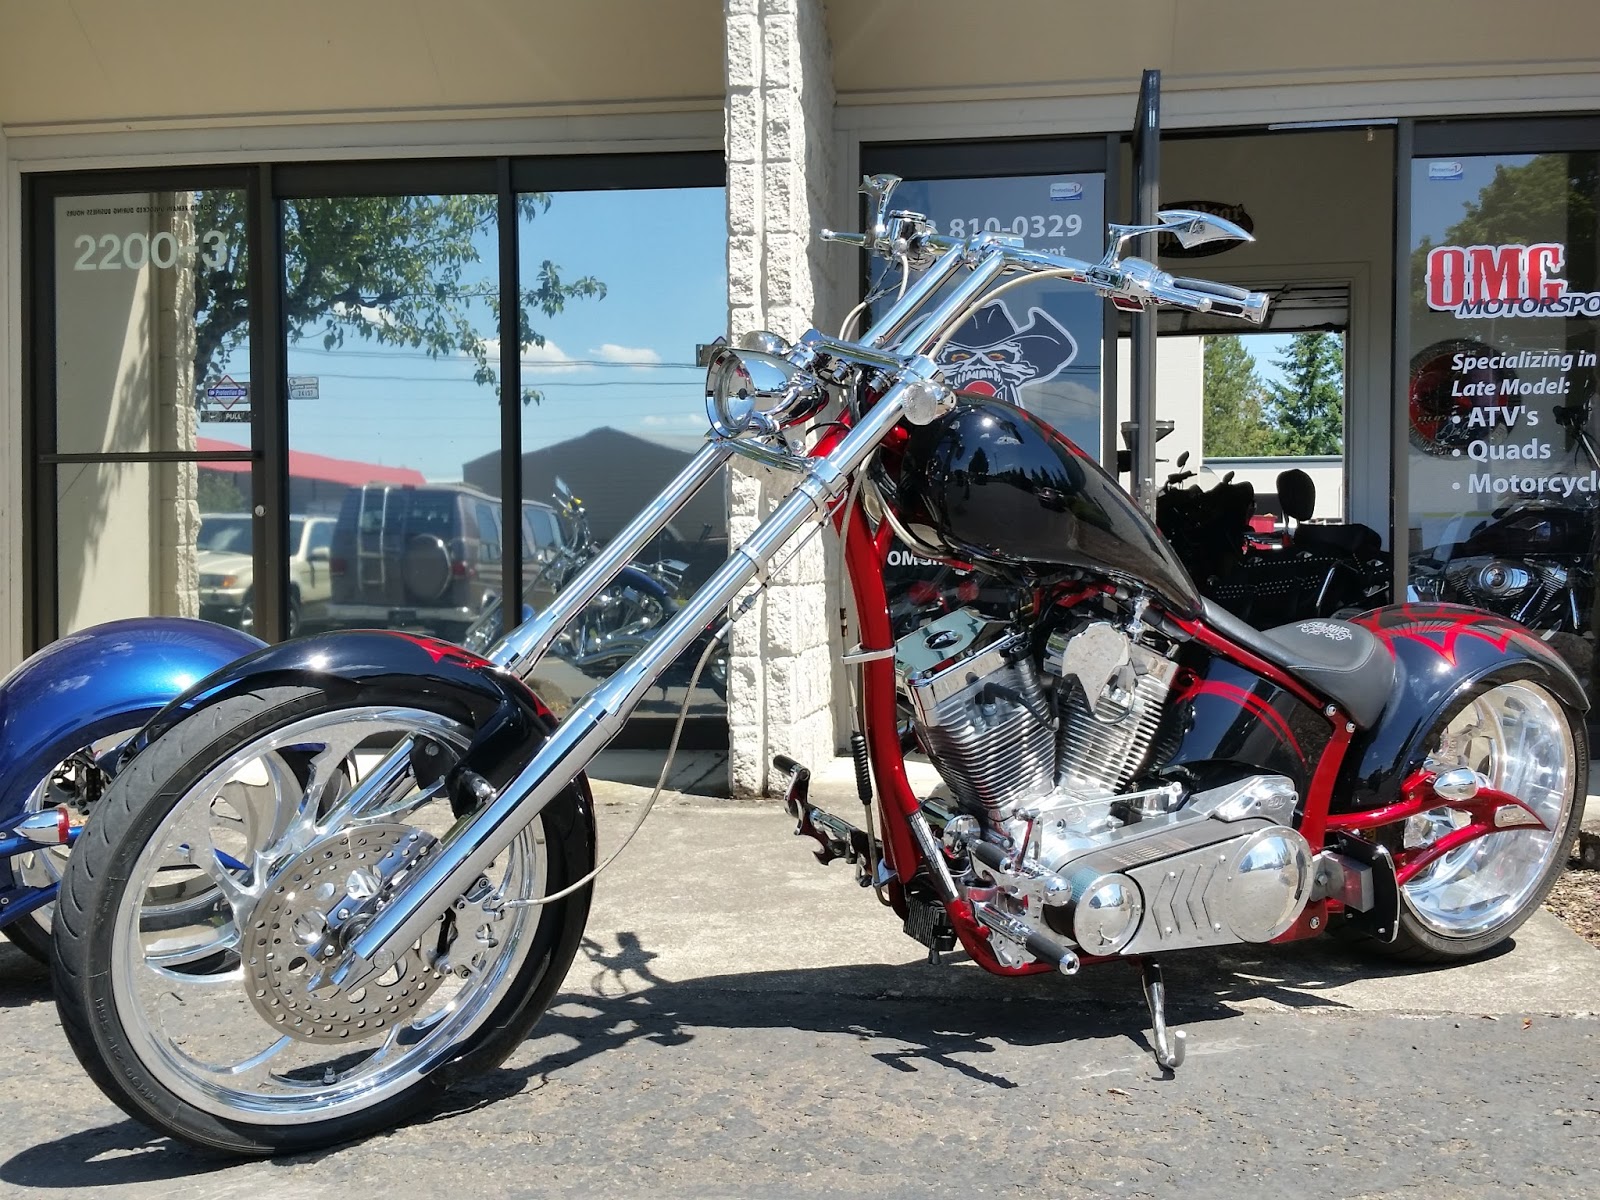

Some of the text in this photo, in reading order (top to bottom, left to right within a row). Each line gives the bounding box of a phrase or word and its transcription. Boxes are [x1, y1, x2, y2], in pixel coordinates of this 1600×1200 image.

[949, 214, 1082, 238] 810-0329
[73, 230, 228, 271] 2200-3
[1428, 245, 1565, 309] OMG
[1451, 350, 1597, 374] Specializing in
[1451, 377, 1571, 397] Late Model:
[1467, 405, 1539, 428] ATV's
[1467, 438, 1551, 463] Quads
[1468, 470, 1600, 498] Motorcycl
